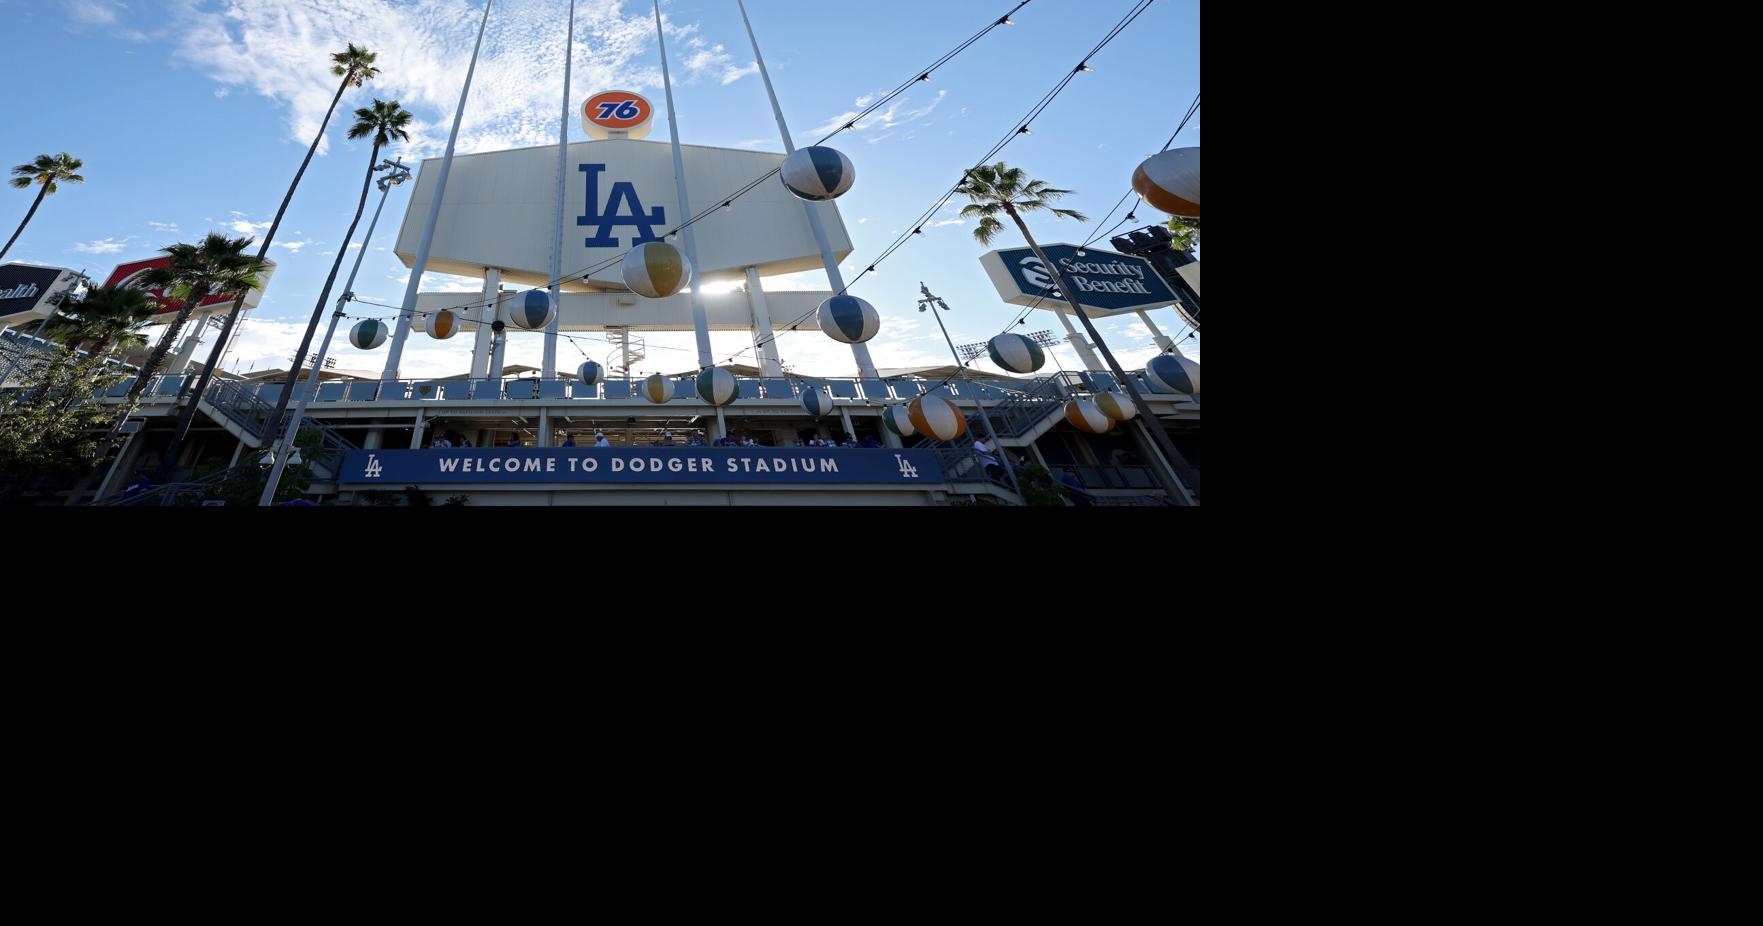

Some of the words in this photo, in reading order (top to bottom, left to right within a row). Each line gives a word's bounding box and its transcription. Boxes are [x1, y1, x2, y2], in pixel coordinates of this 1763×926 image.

[596, 100, 640, 120] 76
[577, 163, 666, 248] LA
[1059, 257, 1145, 280] Security
[1072, 275, 1151, 294] Benefit
[364, 454, 383, 478] LA
[439, 457, 556, 473] WELCOME
[568, 457, 599, 473] TO
[611, 457, 715, 473] DODGER
[727, 457, 839, 473] STADIUM
[894, 454, 919, 478] LA
